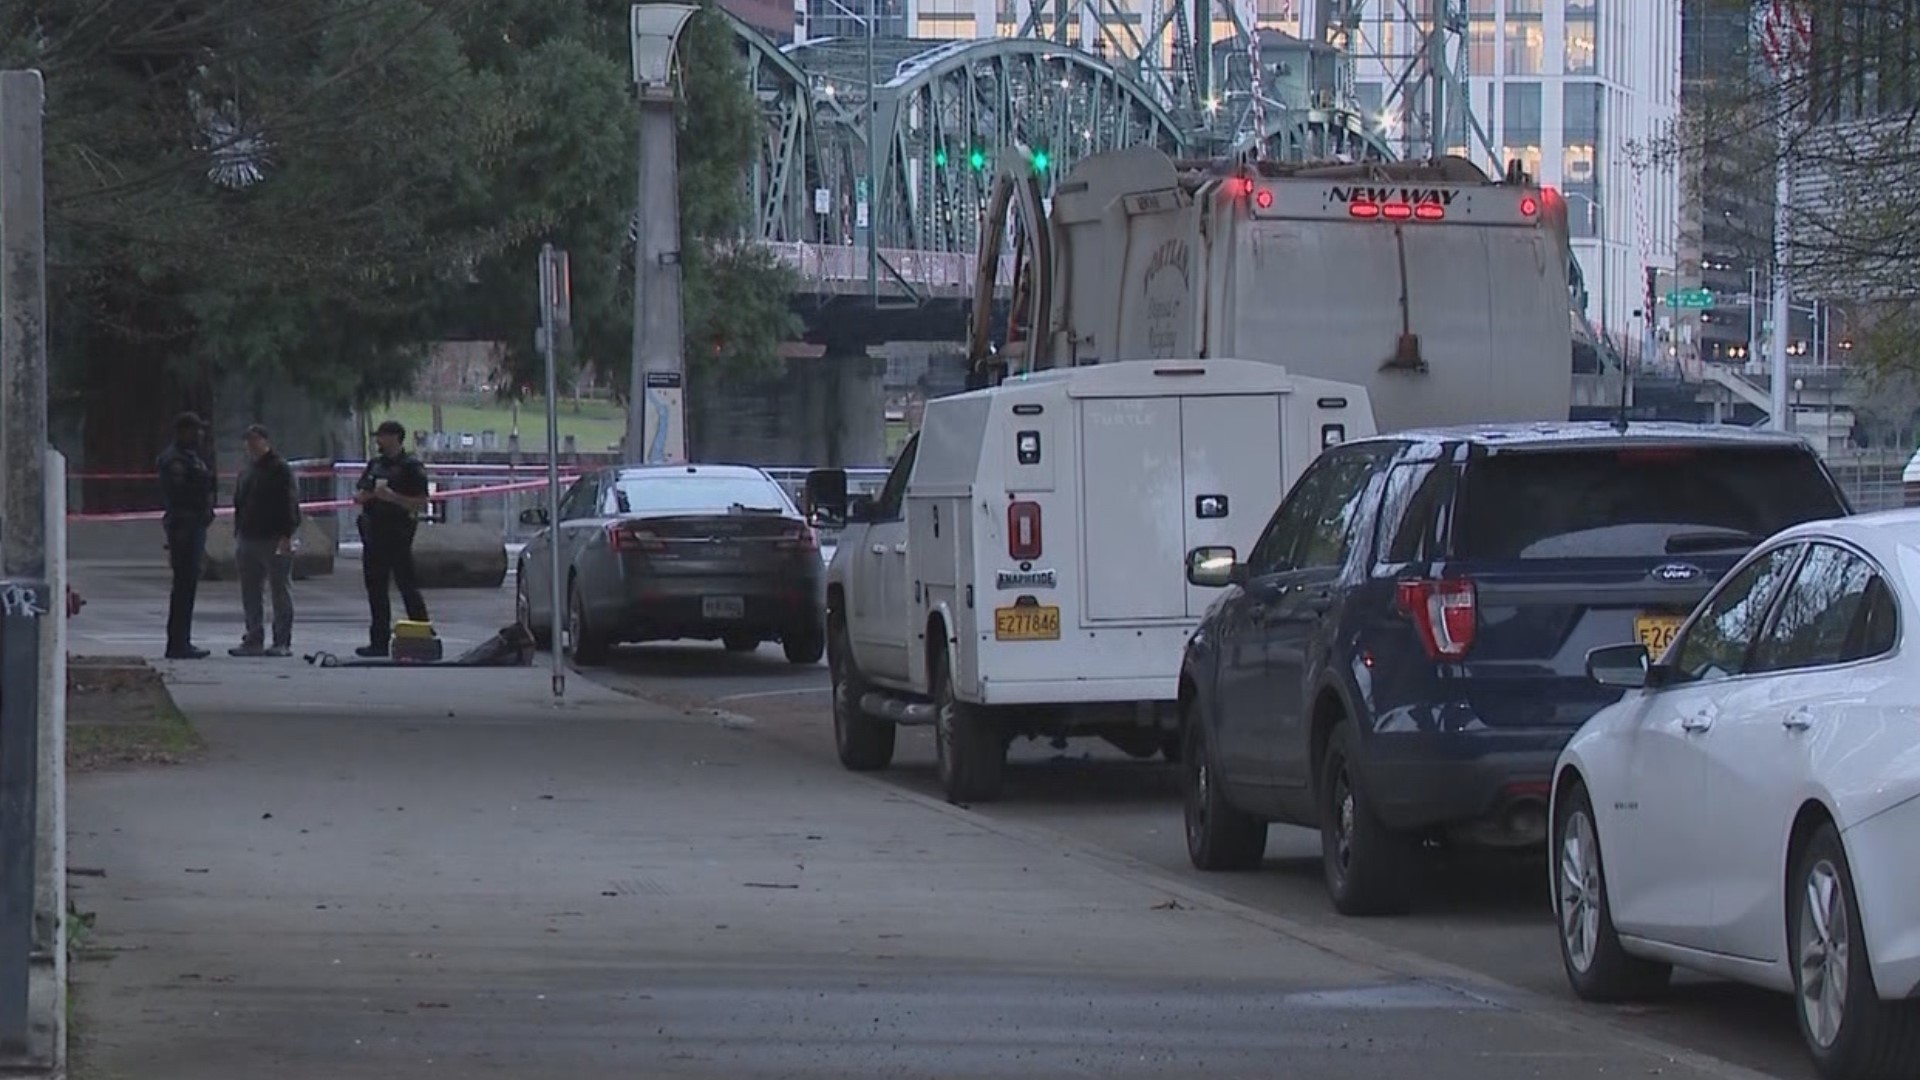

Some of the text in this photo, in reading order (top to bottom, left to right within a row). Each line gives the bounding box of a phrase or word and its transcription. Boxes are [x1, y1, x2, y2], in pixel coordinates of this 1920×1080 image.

[1329, 186, 1460, 205] NEW WAY
[997, 614, 1057, 634] E277846
